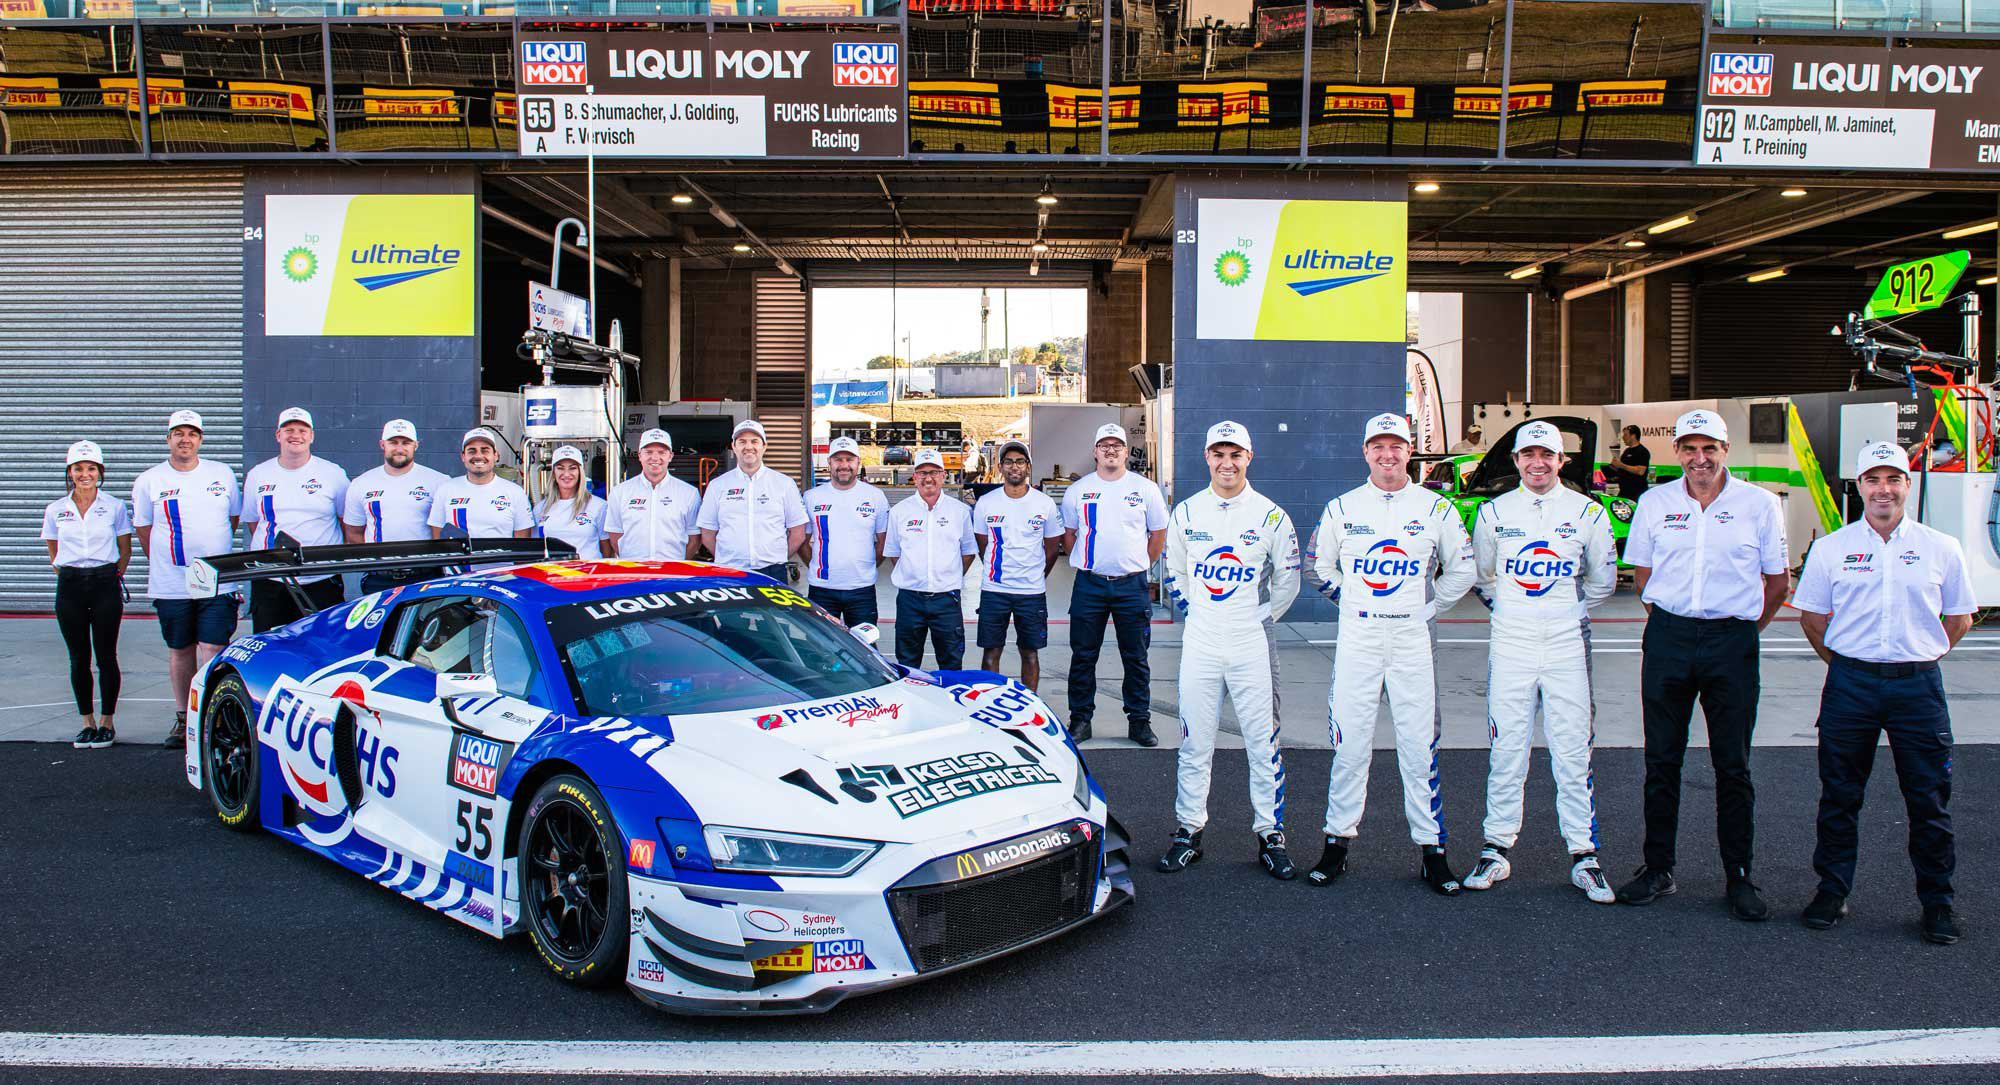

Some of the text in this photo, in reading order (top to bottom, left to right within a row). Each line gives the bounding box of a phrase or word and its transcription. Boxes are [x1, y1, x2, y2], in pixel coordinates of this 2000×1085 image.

[525, 43, 583, 64] LIQUI
[837, 45, 896, 64] LIQUI
[525, 64, 586, 83] MOLY
[608, 49, 811, 80] LIQUI MOLY
[1712, 55, 1771, 75] LIQUI
[837, 66, 897, 85] MOLY
[1711, 75, 1770, 95] MOLY
[1792, 62, 1984, 94] LIQUI MOLY
[526, 102, 552, 129] 55
[564, 103, 739, 125] B. Schumacher, J. Golding,
[773, 104, 898, 124] FUCHS Lubricants
[1705, 109, 1734, 140] 912
[1744, 114, 1897, 136] M.Campbell, M. Jaminet,
[1964, 119, 2000, 138] Man
[535, 137, 547, 153] A
[565, 127, 576, 145] F.
[811, 130, 860, 152] Racing
[1712, 147, 1723, 163] A
[1742, 138, 1807, 160] T. Preining
[1977, 144, 2000, 163] EM
[243, 228, 263, 240] 24
[304, 232, 320, 245] bp
[1176, 230, 1196, 243] 23
[1237, 236, 1253, 249] bp
[350, 243, 461, 265] ultimate
[1283, 249, 1394, 271] ultimate
[1889, 262, 1935, 309] 912
[527, 405, 553, 420] 55
[1642, 426, 1677, 437] MANTHE
[301, 482, 322, 490] FUCHS
[408, 490, 430, 498] FUCHS
[490, 499, 511, 507] FUCHS
[1124, 495, 1144, 504] FUCHS
[856, 506, 875, 514] FUCHS
[1239, 534, 1260, 542] FUCHS
[1193, 563, 1256, 582] FUCHS
[1353, 558, 1420, 577] FUCHS
[1505, 559, 1574, 577] FUCHS
[584, 587, 812, 620] LIQUI MOLY 55
[783, 695, 882, 724] PremiAir
[837, 702, 904, 727] Racing
[264, 688, 399, 799] FUCHS
[458, 735, 499, 766] LIQUI
[456, 760, 496, 790] MOLY
[908, 752, 1006, 784] KELSO
[890, 764, 1058, 816] ELECTRICAL
[558, 783, 604, 826] PIRELLI
[455, 799, 494, 861] 55
[983, 831, 1071, 867] McDonald's
[457, 861, 487, 886] PAM
[802, 913, 836, 925] Sydney
[793, 925, 846, 937] Helicopters
[815, 940, 862, 957] LIQUI
[639, 960, 663, 972] LIQUI
[815, 955, 865, 972] MOLY
[639, 969, 663, 982] MOLY
